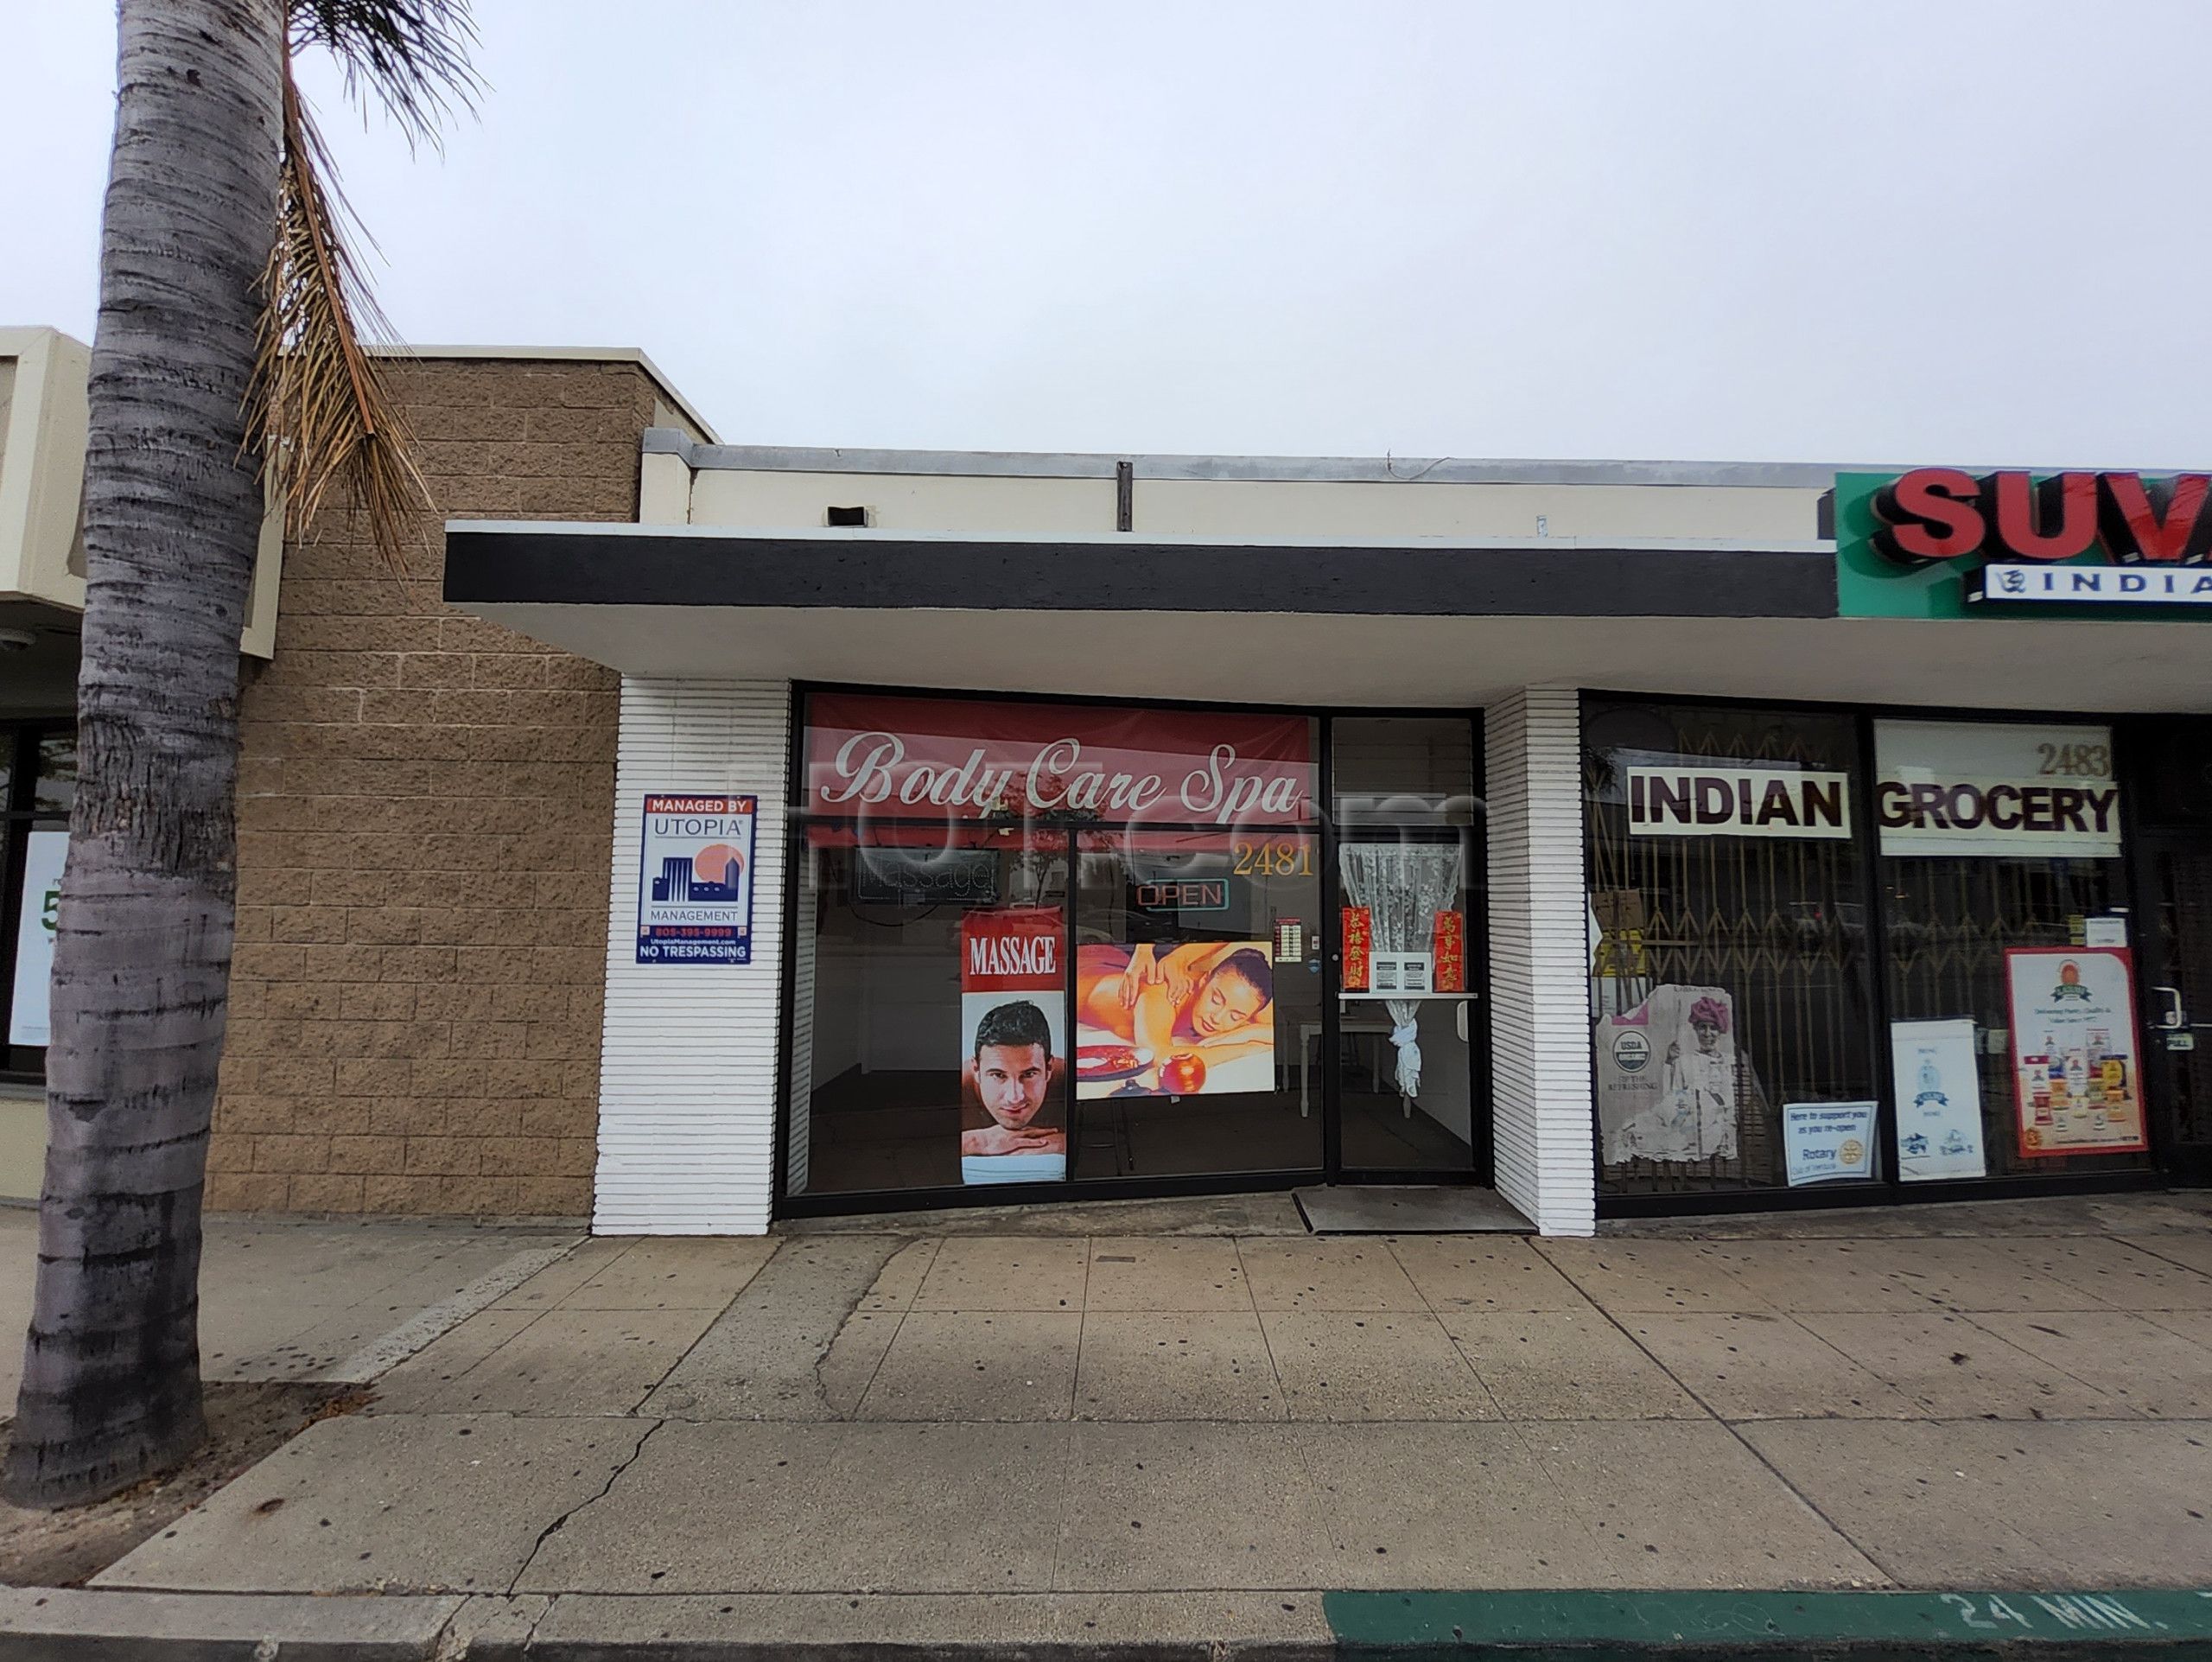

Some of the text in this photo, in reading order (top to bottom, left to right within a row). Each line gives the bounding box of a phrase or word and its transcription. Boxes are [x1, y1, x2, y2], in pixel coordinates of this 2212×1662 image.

[1892, 467, 2212, 560] SUV
[2037, 742, 2110, 777] 2483
[820, 731, 1303, 825] Body Care Spa
[652, 799, 747, 813] MANAGED BY
[1630, 775, 1843, 827] INDIAN
[1876, 780, 2118, 832] GROCERY
[654, 818, 741, 836] UTOPIA
[1233, 842, 1313, 878] 2481
[1137, 882, 1223, 907] OPEN
[650, 910, 739, 922] MANAGEMENT
[639, 946, 747, 958] NO TRESPASSING
[969, 936, 1057, 976] MASSAGE
[1620, 1041, 1643, 1050] USDA
[1790, 1112, 1808, 1121] Here
[1819, 1111, 1850, 1120] support
[1851, 1111, 1867, 1120] you
[1802, 1149, 1836, 1161] Rotary
